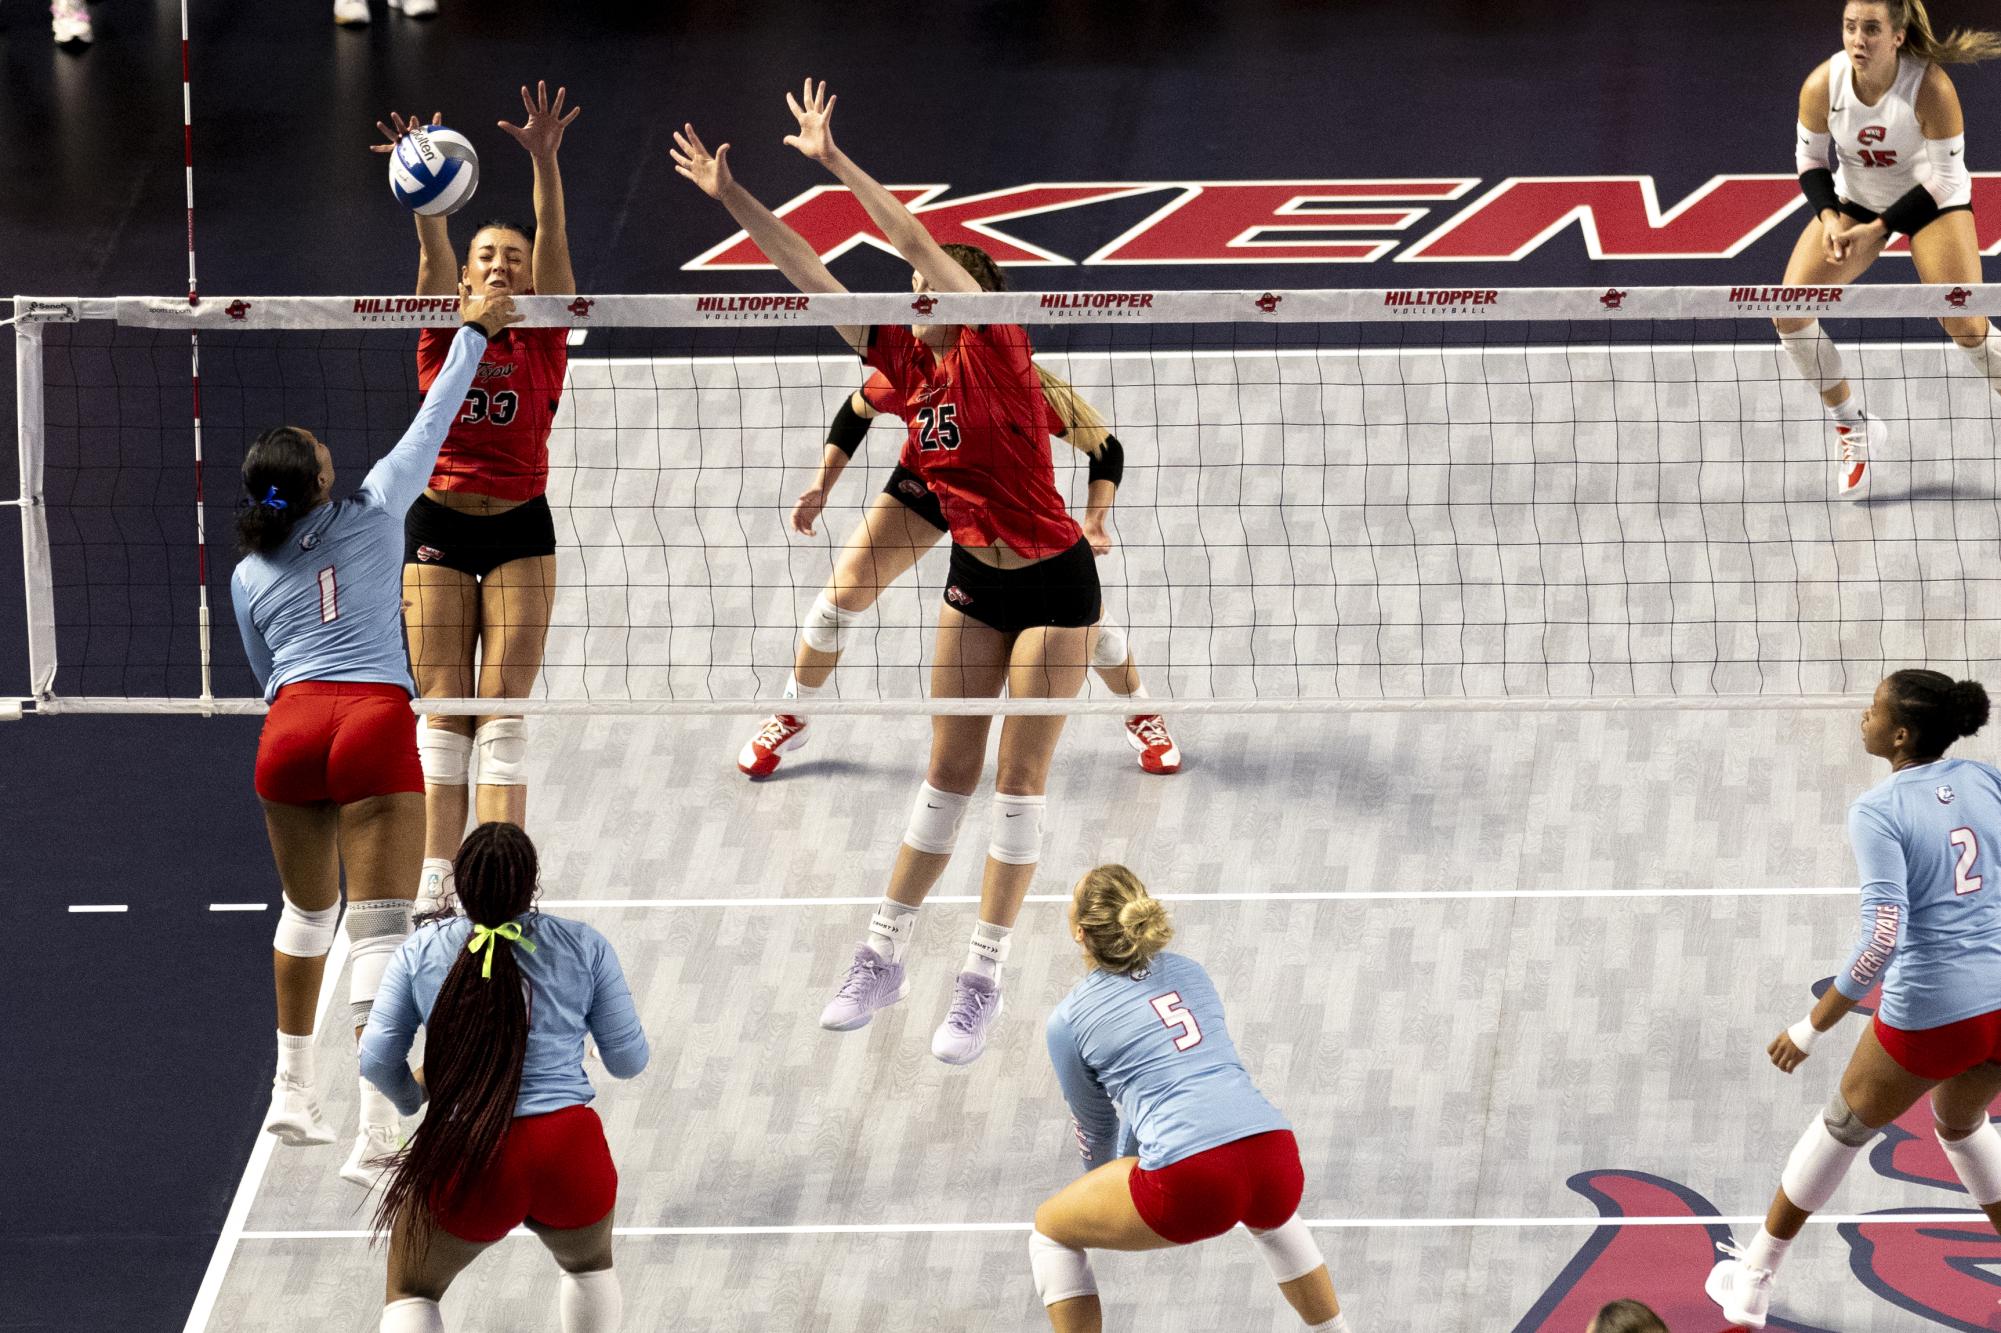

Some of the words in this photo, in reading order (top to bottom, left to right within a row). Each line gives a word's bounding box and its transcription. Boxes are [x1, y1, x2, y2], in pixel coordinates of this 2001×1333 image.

[1857, 149, 1897, 168] 15
[696, 296, 809, 312] HILLTOPPER
[1040, 293, 1153, 308] HILLTOPPER
[1384, 290, 1498, 306] HILLTOPPER
[1729, 287, 1843, 303] HILLTOPPER
[461, 387, 519, 426] 33
[916, 403, 961, 452] 25
[317, 564, 338, 625] 1
[1949, 826, 1983, 896] 2
[1850, 950, 1885, 986] EVER
[1148, 990, 1203, 1053] 5
